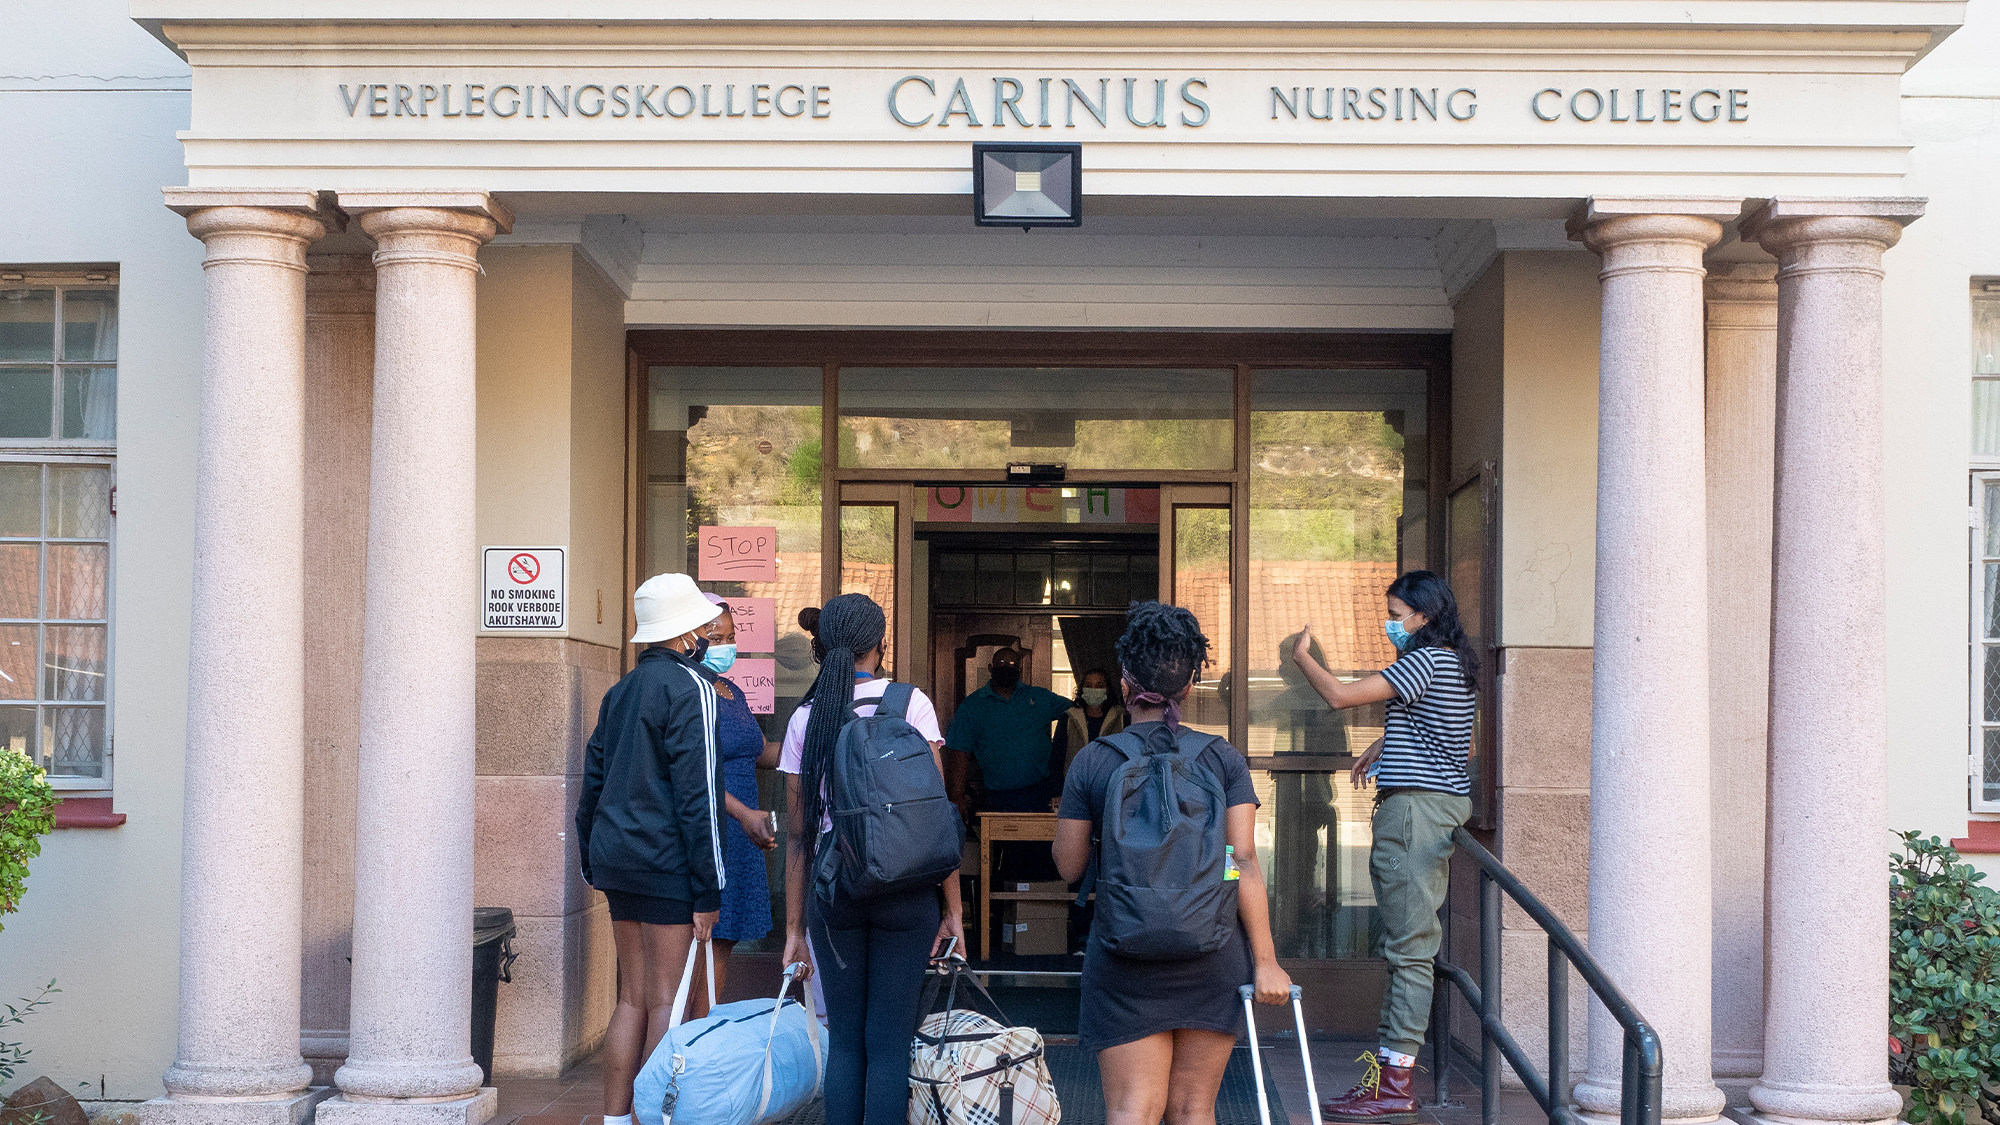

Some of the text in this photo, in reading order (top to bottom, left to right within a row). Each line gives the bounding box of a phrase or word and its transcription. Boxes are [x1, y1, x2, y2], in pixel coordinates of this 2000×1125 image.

[339, 74, 1750, 129] VERPLEGINGSKOLLEGE CARINUS NURSING COLLEGE
[913, 486, 1054, 513] OME
[707, 535, 767, 559] STOP
[491, 589, 556, 600] NO SMOKING
[488, 602, 561, 613] ROOK VERBODE
[730, 605, 755, 616] ASE
[488, 615, 557, 625] AKUTSHAYWA
[742, 676, 775, 688] TURN
